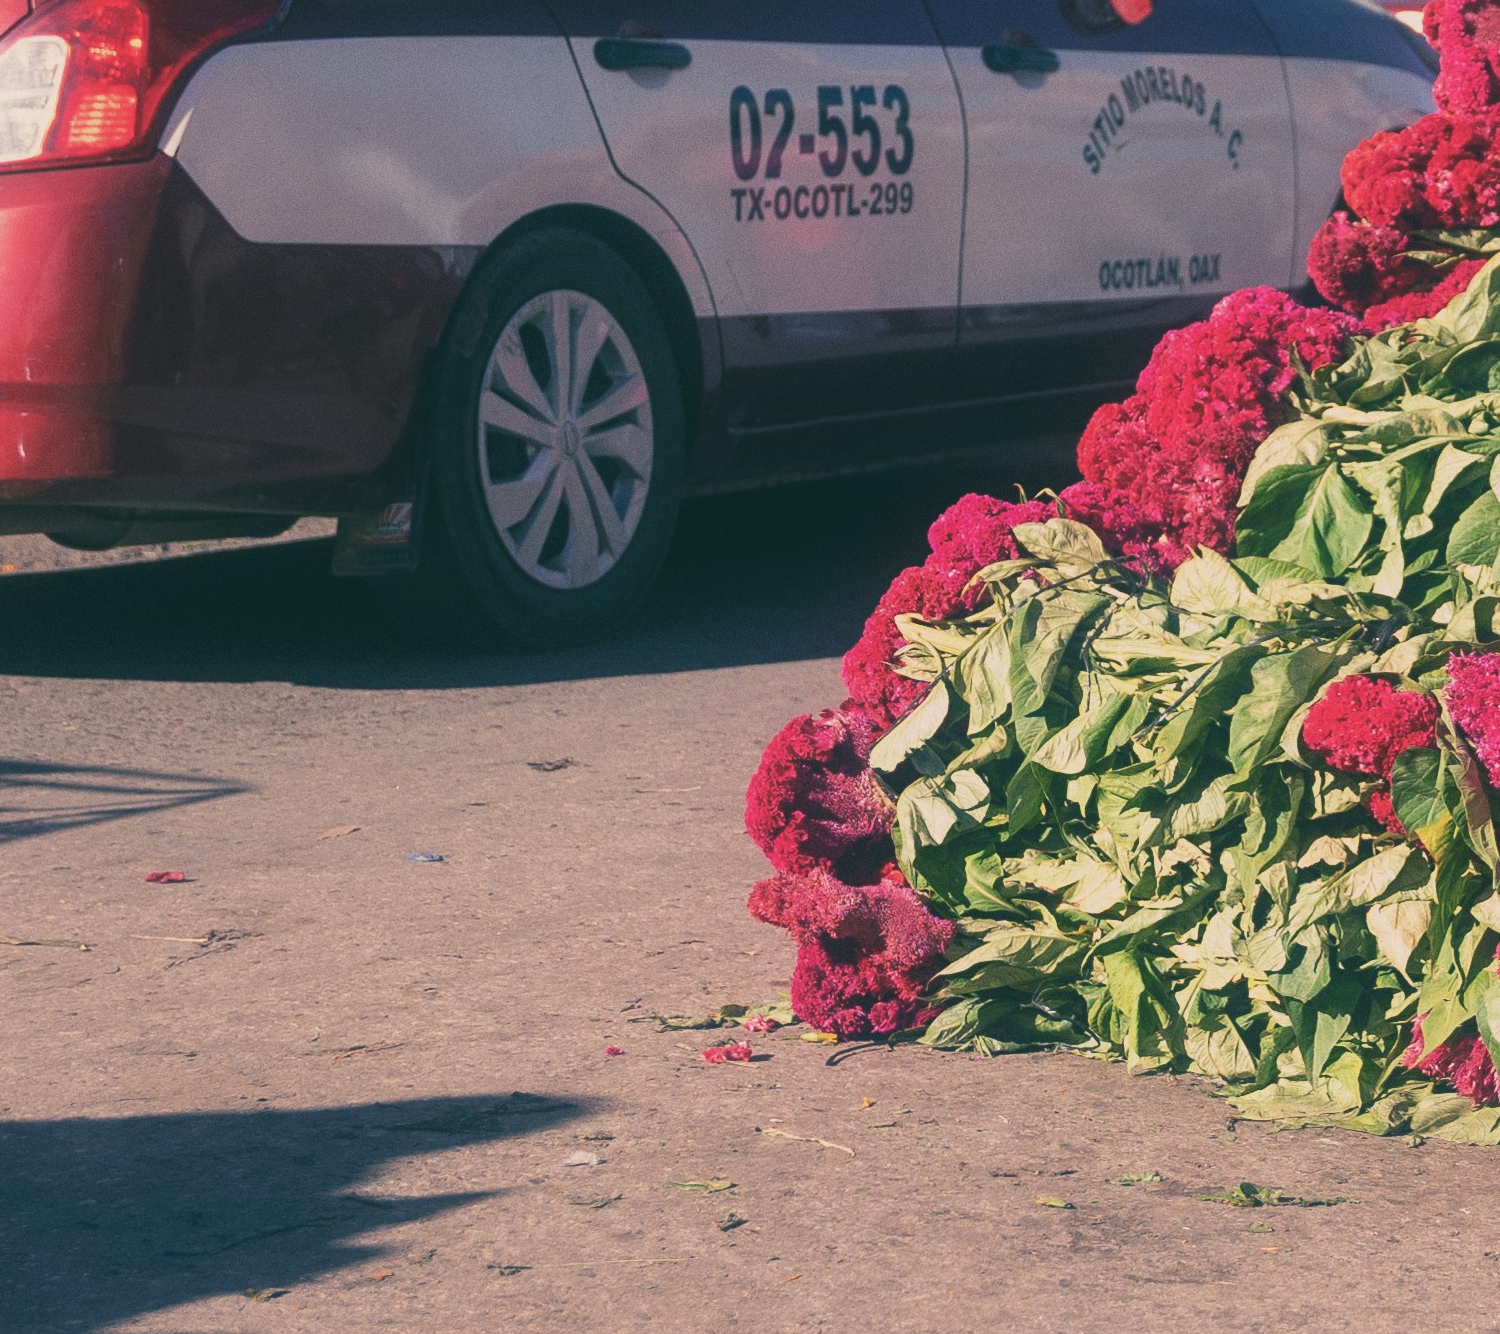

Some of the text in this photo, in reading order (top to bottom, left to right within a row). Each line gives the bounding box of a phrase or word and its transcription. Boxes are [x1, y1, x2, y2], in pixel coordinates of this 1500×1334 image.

[729, 83, 915, 182] 02-553
[1082, 92, 1125, 175] SITIO
[1119, 65, 1207, 117] MORELOS
[730, 181, 914, 223] TX-OCOTL-299
[1099, 249, 1222, 292] OCOTLÁN, OAX
